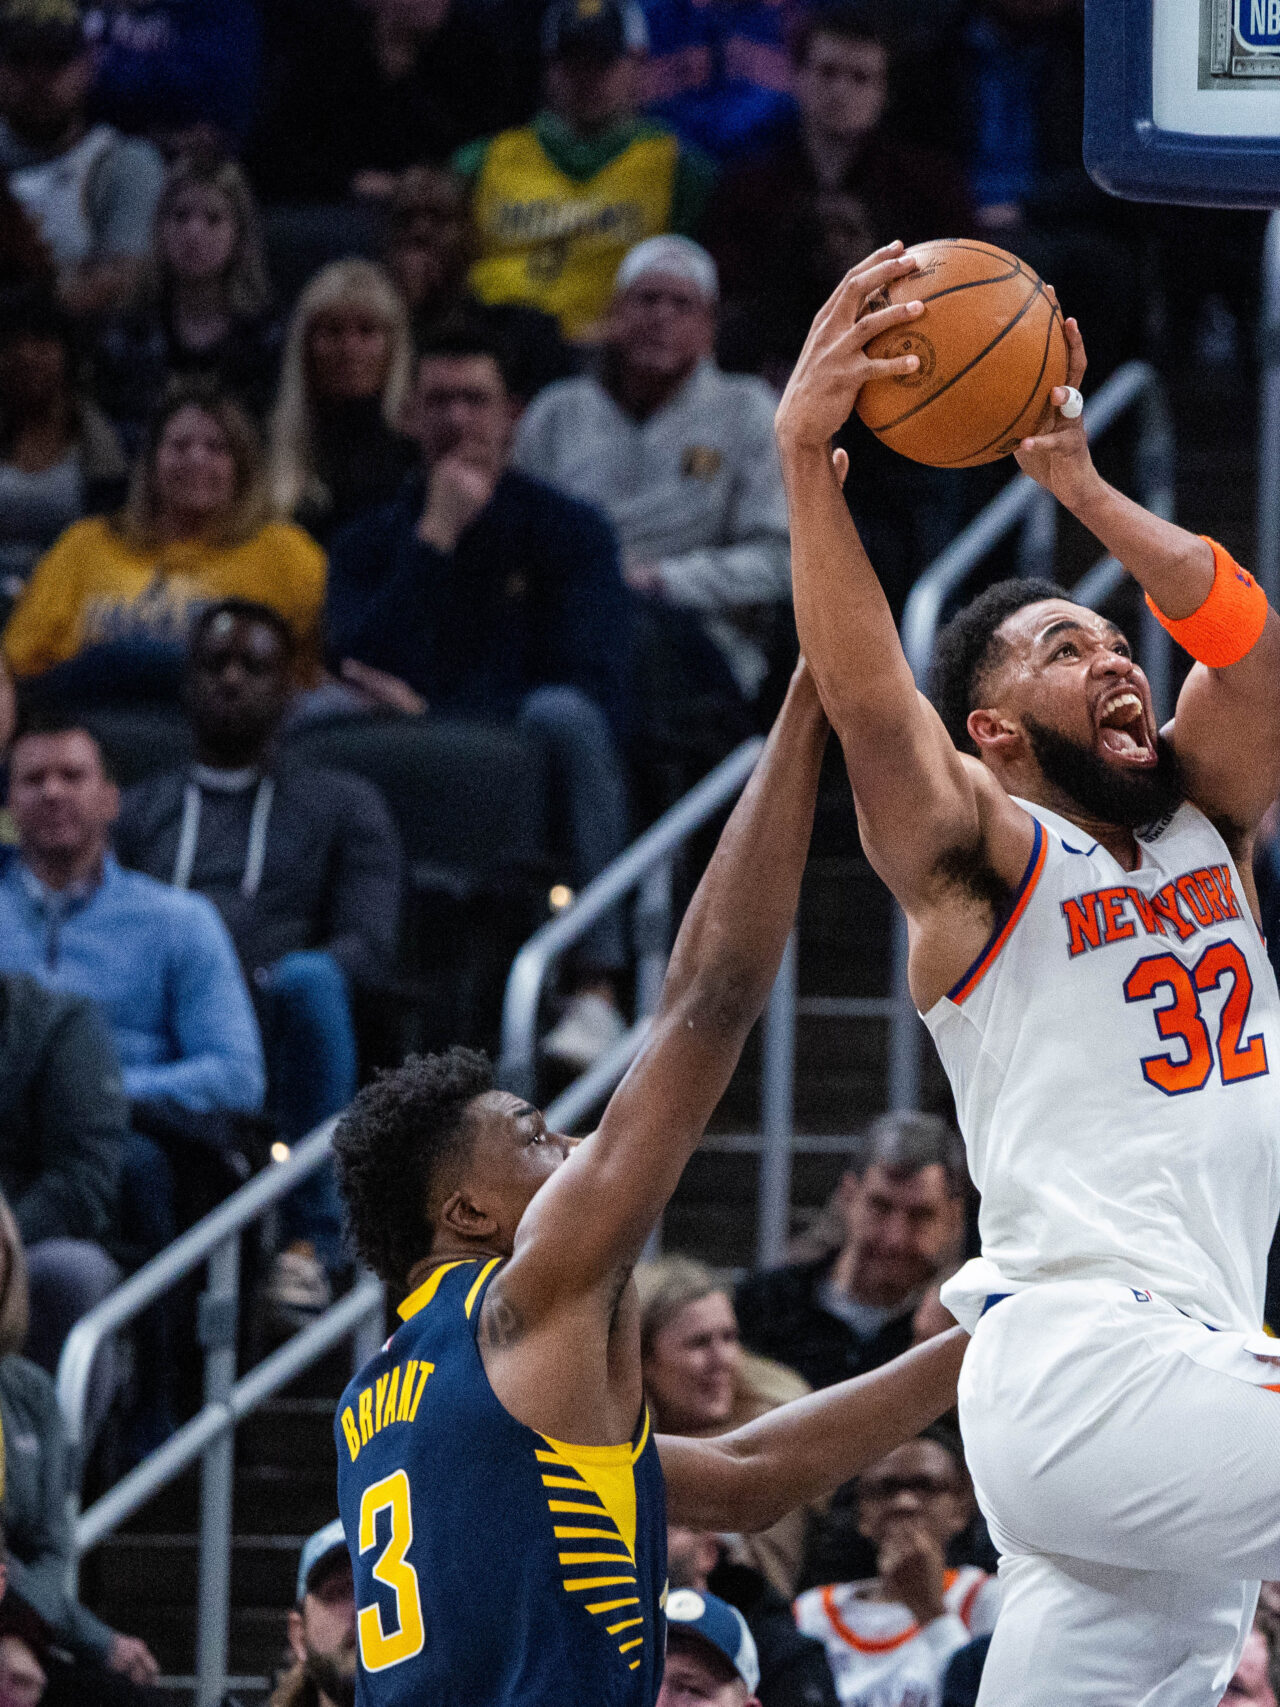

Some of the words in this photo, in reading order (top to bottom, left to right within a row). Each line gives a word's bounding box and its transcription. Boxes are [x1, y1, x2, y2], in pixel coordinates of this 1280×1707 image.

[1060, 885, 1169, 958] NEW
[1150, 862, 1246, 944] YORK
[1123, 938, 1269, 1097] 32
[341, 1360, 436, 1463] BRYANT
[357, 1468, 425, 1673] 3
